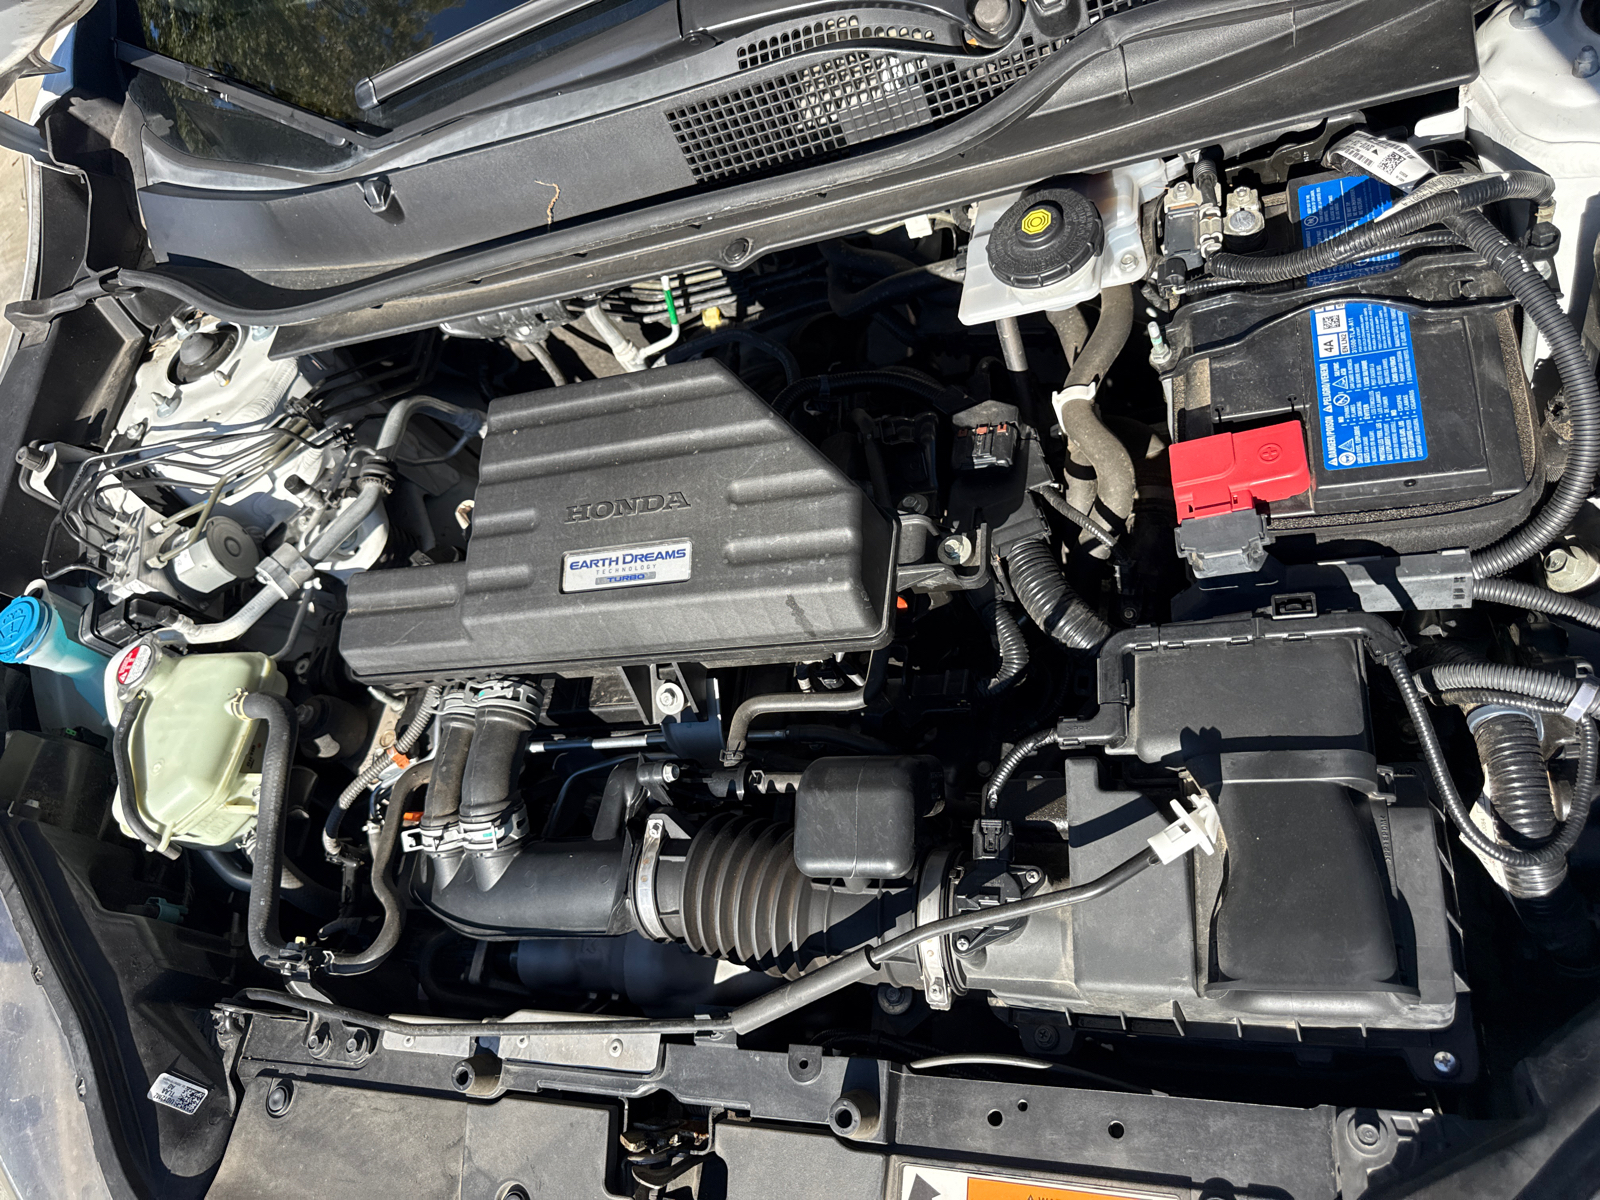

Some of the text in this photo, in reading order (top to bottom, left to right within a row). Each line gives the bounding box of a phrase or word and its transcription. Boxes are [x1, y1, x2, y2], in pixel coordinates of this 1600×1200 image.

[1339, 333, 1347, 344] LN2
[1347, 317, 1357, 353] 31500-TLA-A11
[1322, 339, 1334, 352] 4A
[1318, 362, 1337, 458] DANGER/POISON PELIGRO/VENENO
[564, 491, 691, 524] HONDA
[570, 548, 686, 570] EARTH DREAMS
[596, 564, 657, 575] TECHNOLOGY
[607, 574, 645, 582] TURBO
